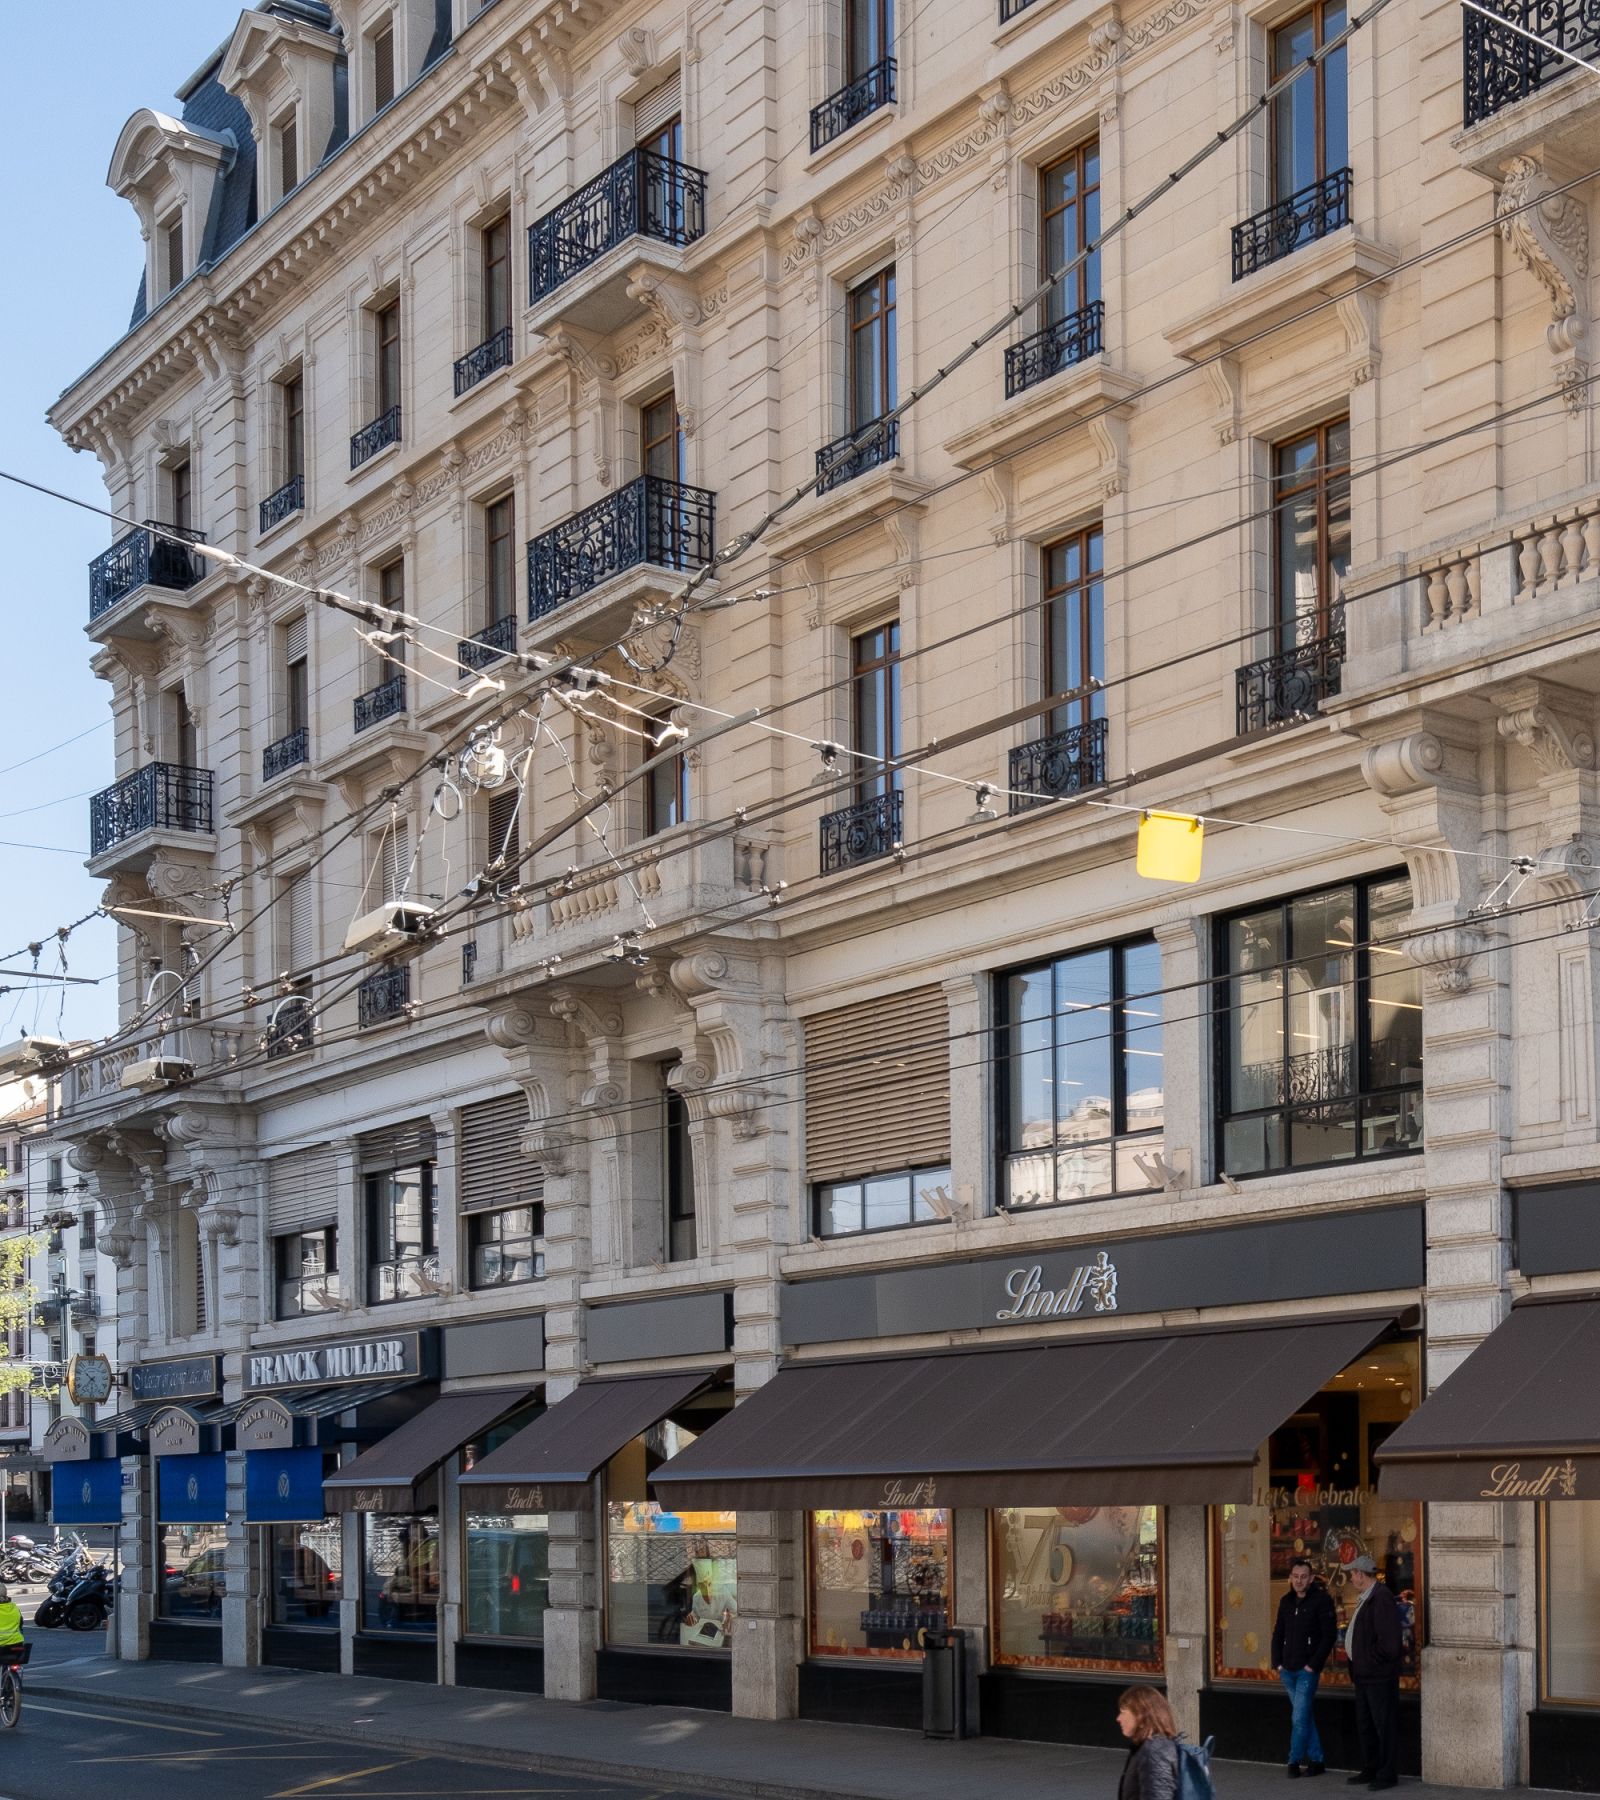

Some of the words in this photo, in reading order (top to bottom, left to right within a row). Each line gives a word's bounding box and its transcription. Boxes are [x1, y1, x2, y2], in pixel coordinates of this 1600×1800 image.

[996, 1265, 1092, 1320] Lindt
[250, 1350, 322, 1386] FRANCK
[325, 1341, 404, 1378] MULLER
[879, 1479, 925, 1506] Lindt
[1480, 1462, 1560, 1497] Lindt
[352, 1489, 379, 1510] Lindt
[504, 1487, 537, 1510] Lindt
[1256, 1486, 1290, 1507] Let's
